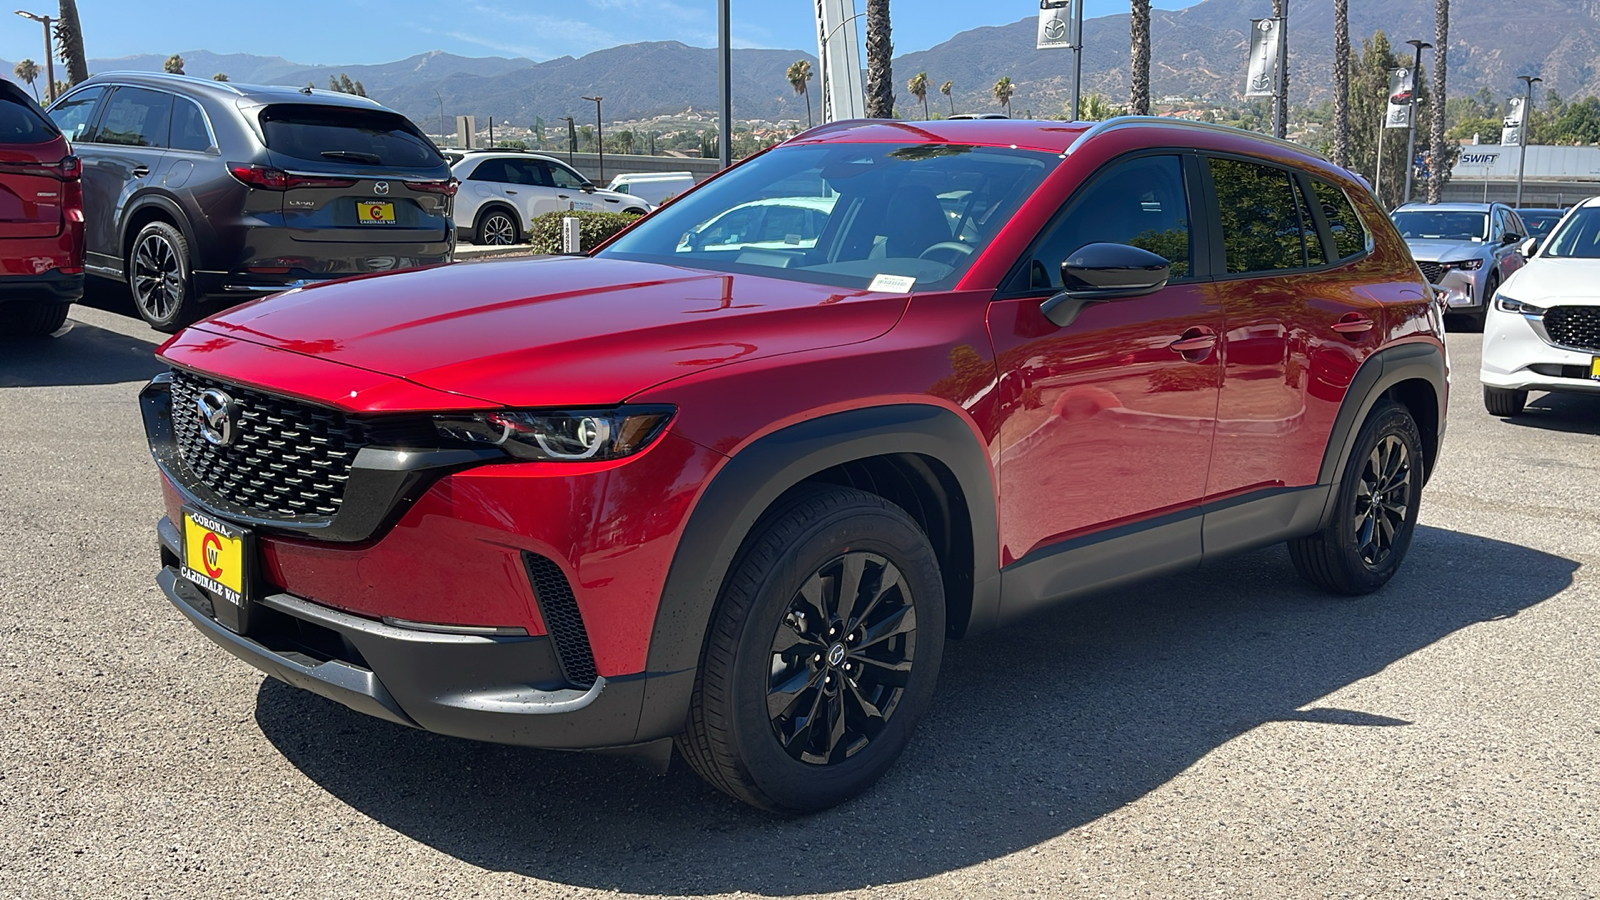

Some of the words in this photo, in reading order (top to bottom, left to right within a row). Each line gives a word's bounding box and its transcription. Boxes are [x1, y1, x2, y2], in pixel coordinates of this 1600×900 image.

[1462, 154, 1498, 163] SWIFT
[193, 512, 228, 535] CORONA
[207, 547, 218, 567] W
[181, 566, 224, 595] CARDINALE
[224, 589, 241, 606] WAY
